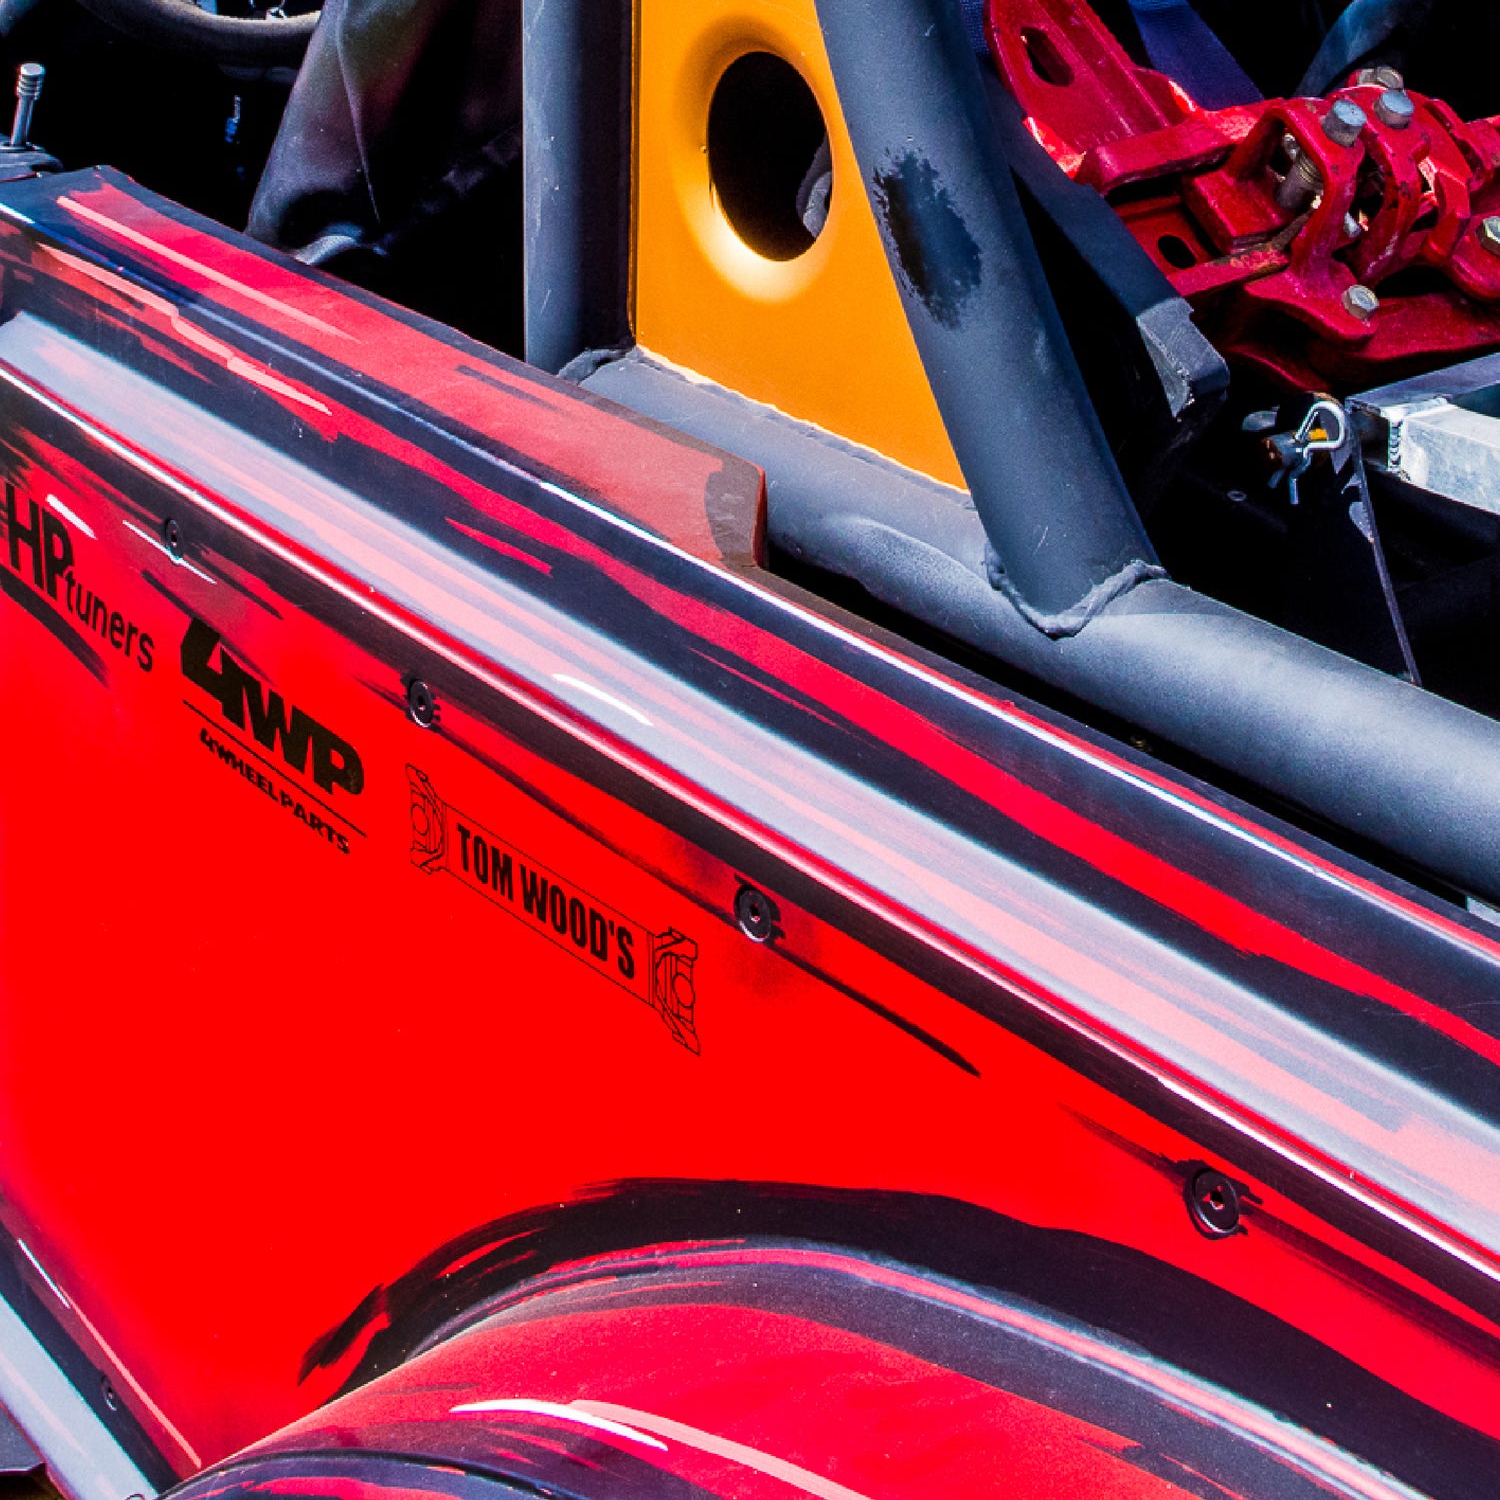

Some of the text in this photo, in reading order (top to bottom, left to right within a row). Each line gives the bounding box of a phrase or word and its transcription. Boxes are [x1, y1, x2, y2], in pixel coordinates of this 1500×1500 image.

[180, 616, 365, 796] 4WP
[457, 823, 635, 980] TOM WOOD'S
